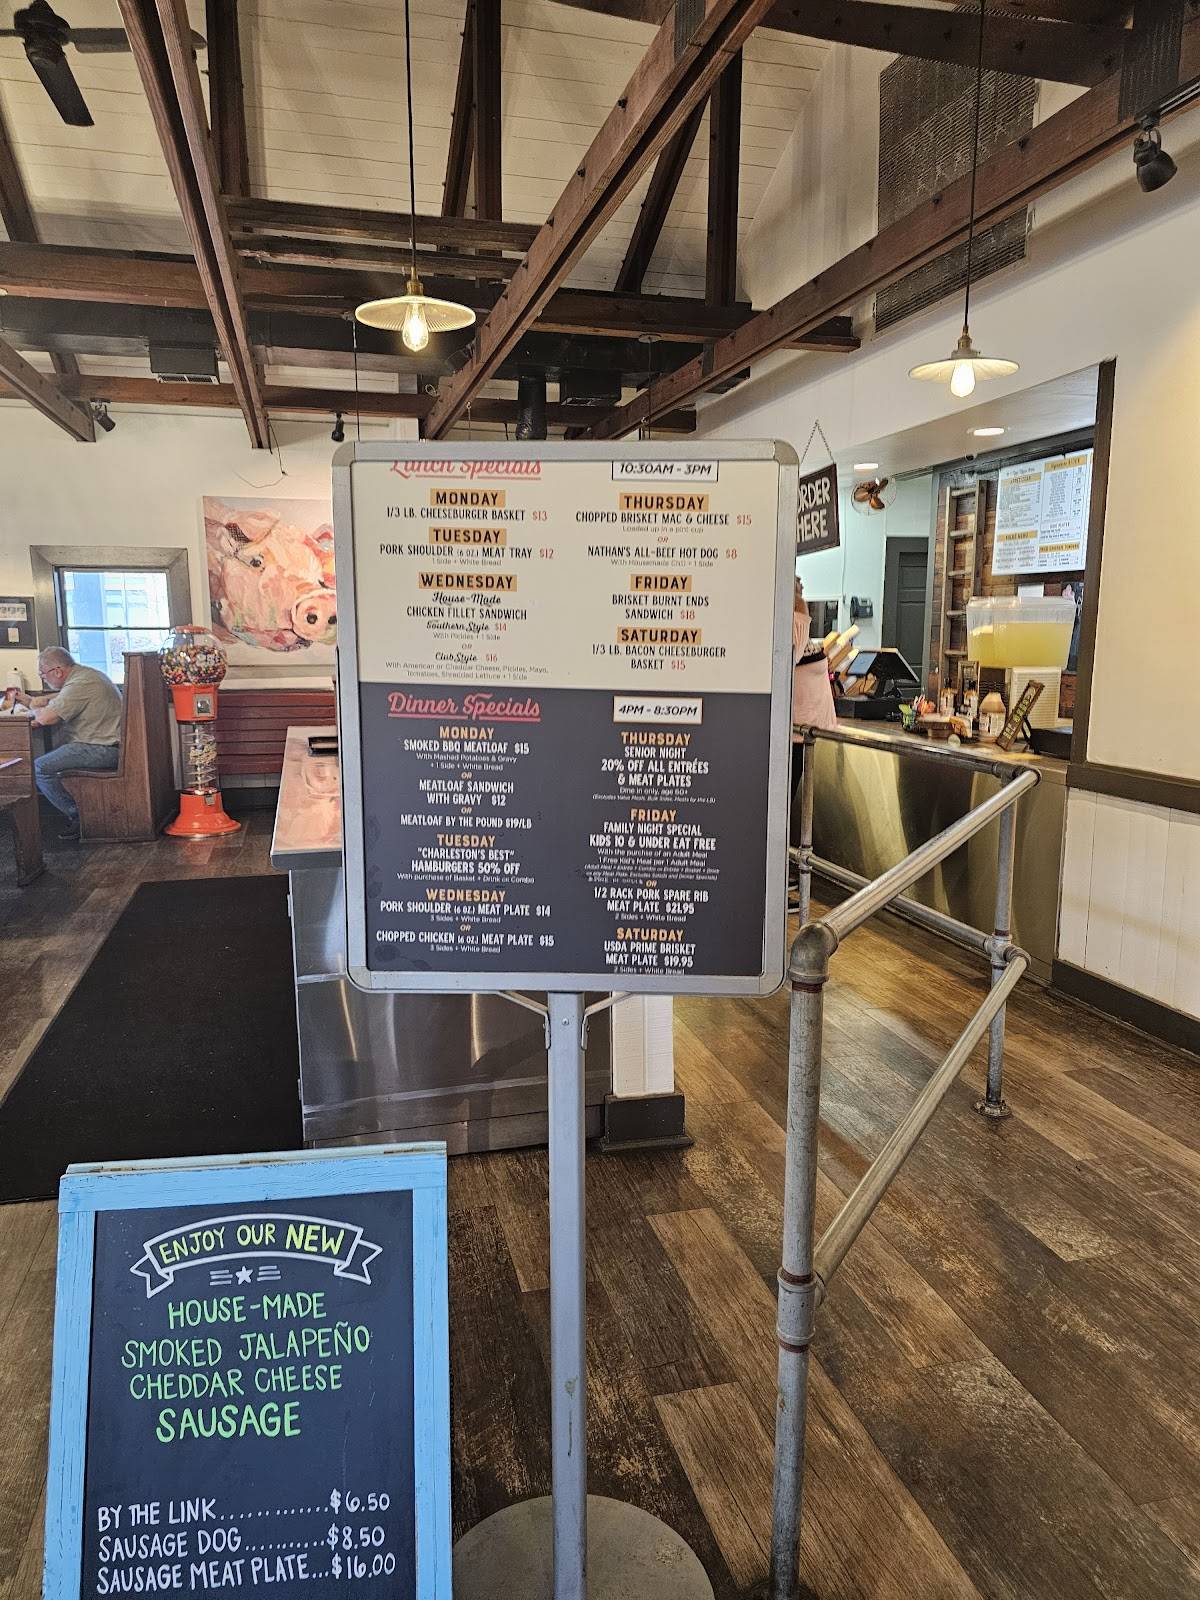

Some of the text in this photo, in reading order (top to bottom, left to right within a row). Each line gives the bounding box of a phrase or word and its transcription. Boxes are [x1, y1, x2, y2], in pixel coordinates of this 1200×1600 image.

[620, 463, 712, 475] 10:30AM 3PM
[436, 492, 498, 505] MONDAY
[624, 496, 704, 510] THURSDAY
[387, 507, 547, 521] 1/3 LB. CHEESEBURGER BASKET $13
[576, 511, 752, 525] CHOPPED BRISKET MAC & CHEESE $15
[797, 509, 828, 543] HERE
[434, 529, 500, 543] TUESDAY
[380, 544, 554, 559] PORK SHOULDER MEAT TRAY $12
[588, 547, 737, 560] NATHAN'S ALL-BEEF HOT DOG $8
[421, 574, 513, 589] WEDNESDAY
[636, 576, 688, 589] FRIDAY
[432, 592, 501, 606] House-Made
[612, 594, 709, 607] BRISKET BURNT ENDS
[407, 606, 527, 620] CHICKEN FILLET SANDWICH
[625, 609, 695, 620] SANDWICH $18
[622, 629, 698, 643] SATURDAY
[593, 644, 726, 657] 1/3 LB. BACON CHEESEBURGER
[631, 659, 685, 670] BASKET $15
[388, 692, 540, 720] Dinner Specials
[619, 705, 698, 716] 4PM 8:30PM
[439, 727, 495, 739] MONDAY
[621, 732, 691, 745] THURSDAY
[404, 739, 529, 754] SMOKED BBQ MEATLOAF $15
[625, 746, 686, 758] SENIOR NIGHT
[602, 758, 709, 774] 20% OFF ALL ENTRÉES
[419, 780, 514, 793] MEATLOAF SANDWICH
[618, 774, 691, 787] & MEAT PLATES
[427, 793, 506, 806] WITH GRAVY $12
[401, 815, 443, 825] MEATLOAF
[446, 816, 455, 826] BY
[459, 816, 473, 827] THE
[476, 817, 503, 828] POUND
[631, 809, 677, 822] FRIDAY
[604, 822, 702, 836] FAMILY NIGHT SPECIAL
[437, 834, 496, 847] TUESDAY
[590, 835, 716, 850] KIDS 10 & UNDER EAT FREE
[411, 861, 520, 874] HAMBURGERS 50% OFF
[426, 888, 506, 902] WEDNESDAY
[594, 887, 708, 902] 1/2 RACK PORK SPARE RIB
[381, 901, 550, 916] PORK SHOULDER MEAT PLATE $14
[607, 901, 694, 914] MEAT PLATE $21.95
[376, 931, 554, 946] CHOPPED CHICKEN MEAT PLATE $15
[617, 928, 684, 941] SATURDAY
[604, 941, 696, 954] USDA PRIME BRISKET
[606, 954, 693, 967] MEAT PLATE $19.95
[158, 1223, 345, 1264] ENJOY OUR NEW
[168, 1292, 326, 1329] HOUSE-MADE
[121, 1321, 370, 1369] SMOKED JALAPEÑO
[129, 1364, 343, 1400] CHEDDAR CHEESE
[156, 1401, 301, 1443] SAUSAGE
[98, 1505, 120, 1531] BY
[128, 1502, 159, 1526] THE
[98, 1531, 188, 1562] SAUSAGE
[97, 1564, 182, 1595] SAUSAGE
[190, 1558, 245, 1590] MEAT
